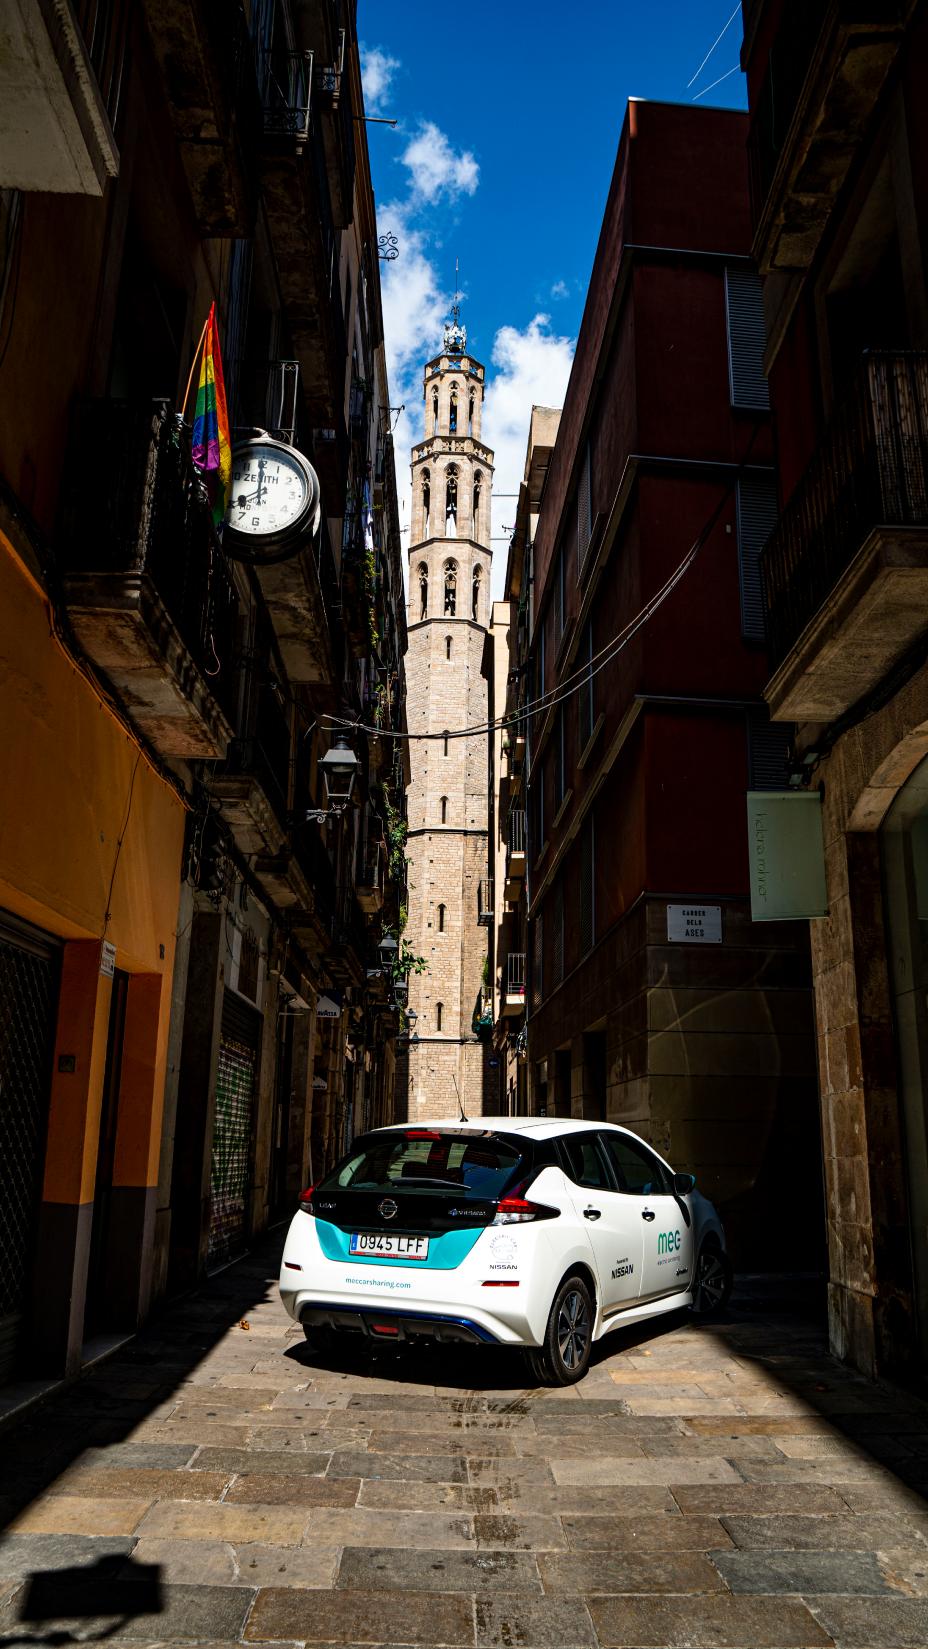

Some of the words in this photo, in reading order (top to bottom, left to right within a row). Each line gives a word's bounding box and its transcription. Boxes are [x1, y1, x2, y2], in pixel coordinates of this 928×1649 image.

[244, 474, 279, 484] ZEITH
[238, 511, 246, 520] 7
[685, 928, 705, 937] ASES
[359, 1235, 393, 1251] 0945
[397, 1237, 425, 1253] LFF
[612, 1264, 634, 1279] NISSAN
[345, 1277, 412, 1289] meccarsharing.com
